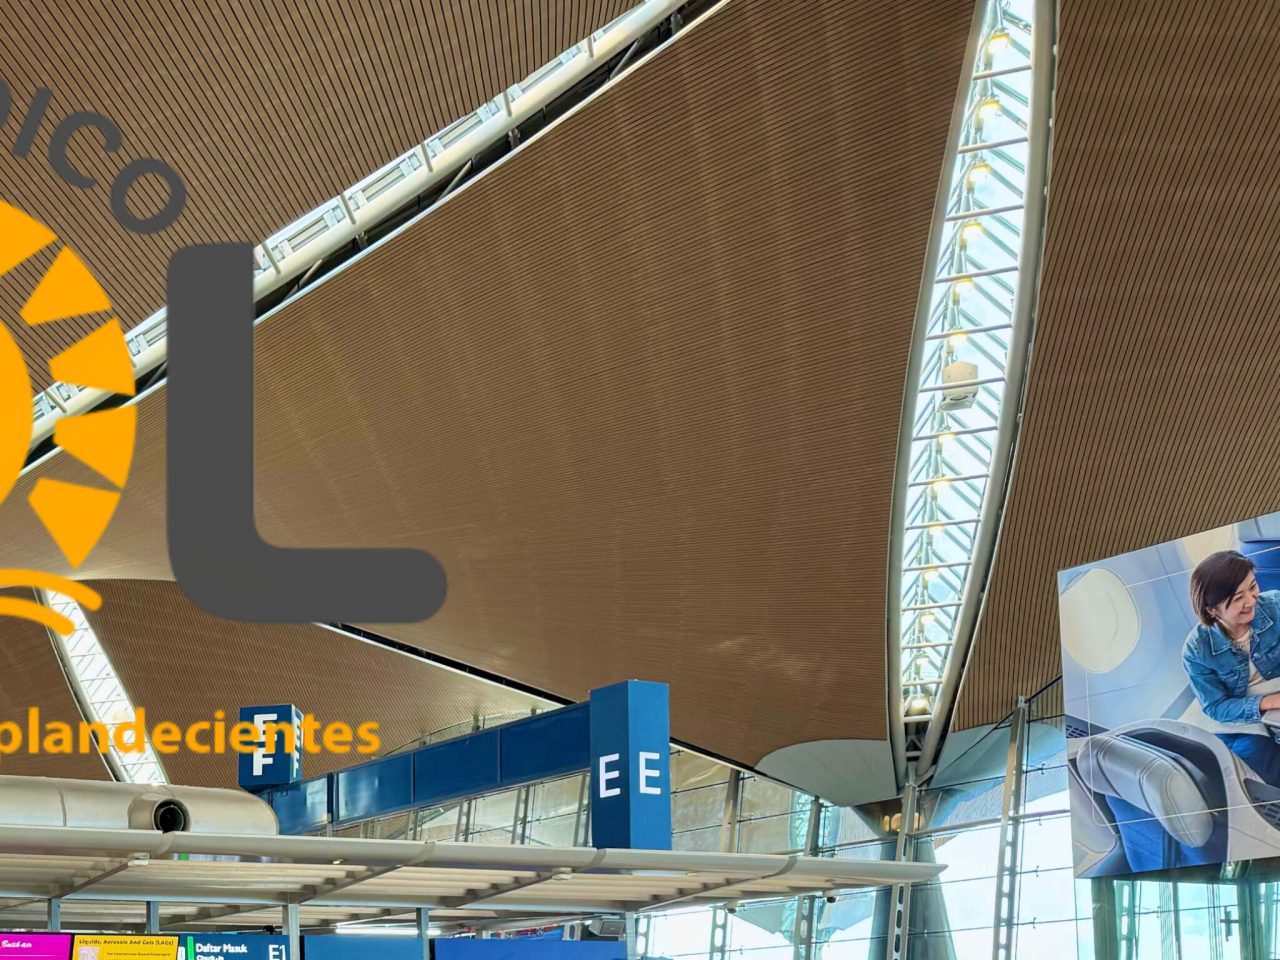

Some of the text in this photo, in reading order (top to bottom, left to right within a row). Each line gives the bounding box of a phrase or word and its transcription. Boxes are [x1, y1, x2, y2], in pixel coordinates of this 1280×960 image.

[599, 752, 621, 798] E
[638, 751, 661, 795] E
[196, 943, 248, 953] Daftar Masuk
